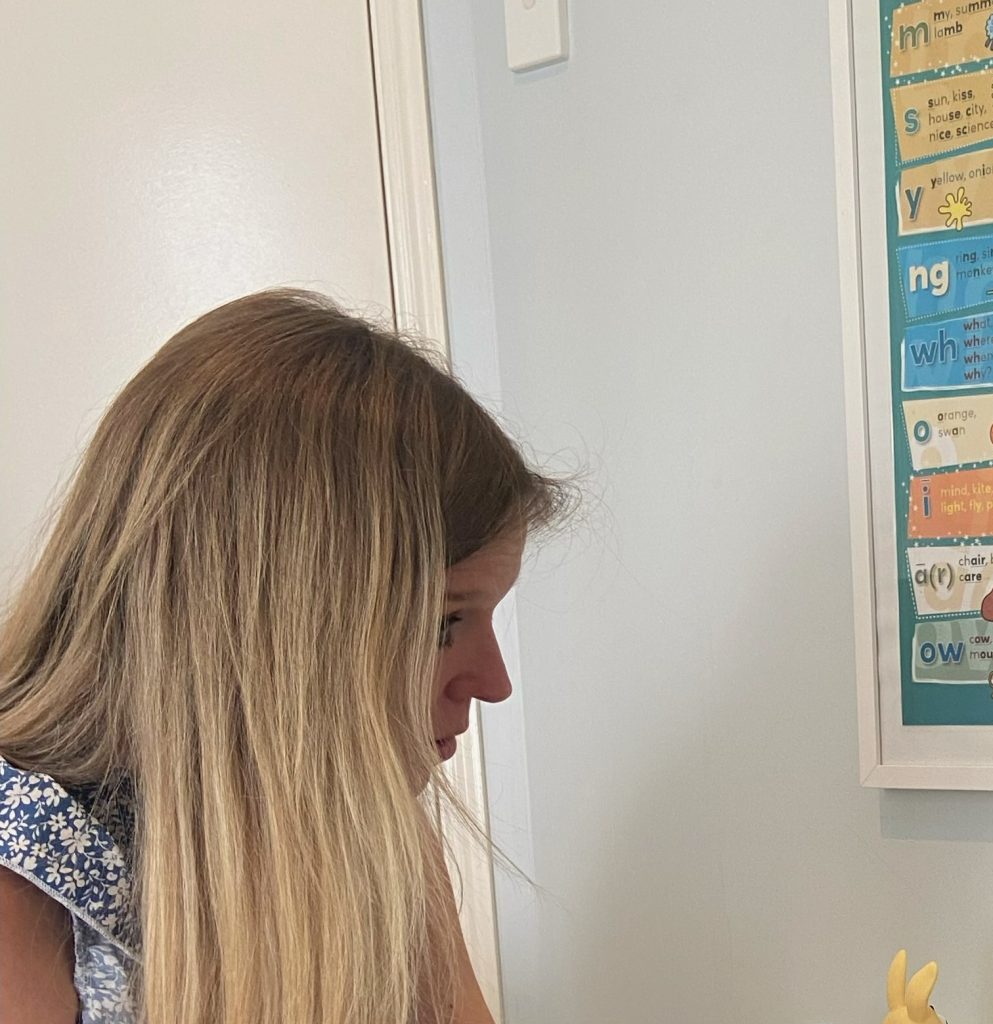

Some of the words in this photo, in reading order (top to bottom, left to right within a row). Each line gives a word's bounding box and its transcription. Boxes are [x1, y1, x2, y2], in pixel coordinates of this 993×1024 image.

[933, 10, 952, 22] my,
[899, 21, 929, 50] m
[934, 21, 963, 37] lamb
[928, 98, 949, 108] sun,
[952, 90, 975, 101] kiss,
[928, 109, 963, 125] house,
[966, 104, 987, 117] city,
[929, 130, 953, 142] nice,
[931, 172, 967, 189] yellow,
[908, 260, 949, 296] ng
[910, 329, 957, 365] wh
[964, 366, 992, 380] why?
[938, 409, 976, 422] orange,
[938, 426, 966, 437] swan
[959, 554, 987, 567] chair,
[959, 572, 982, 581] care
[970, 634, 992, 645] cow,
[920, 642, 963, 663] ow
